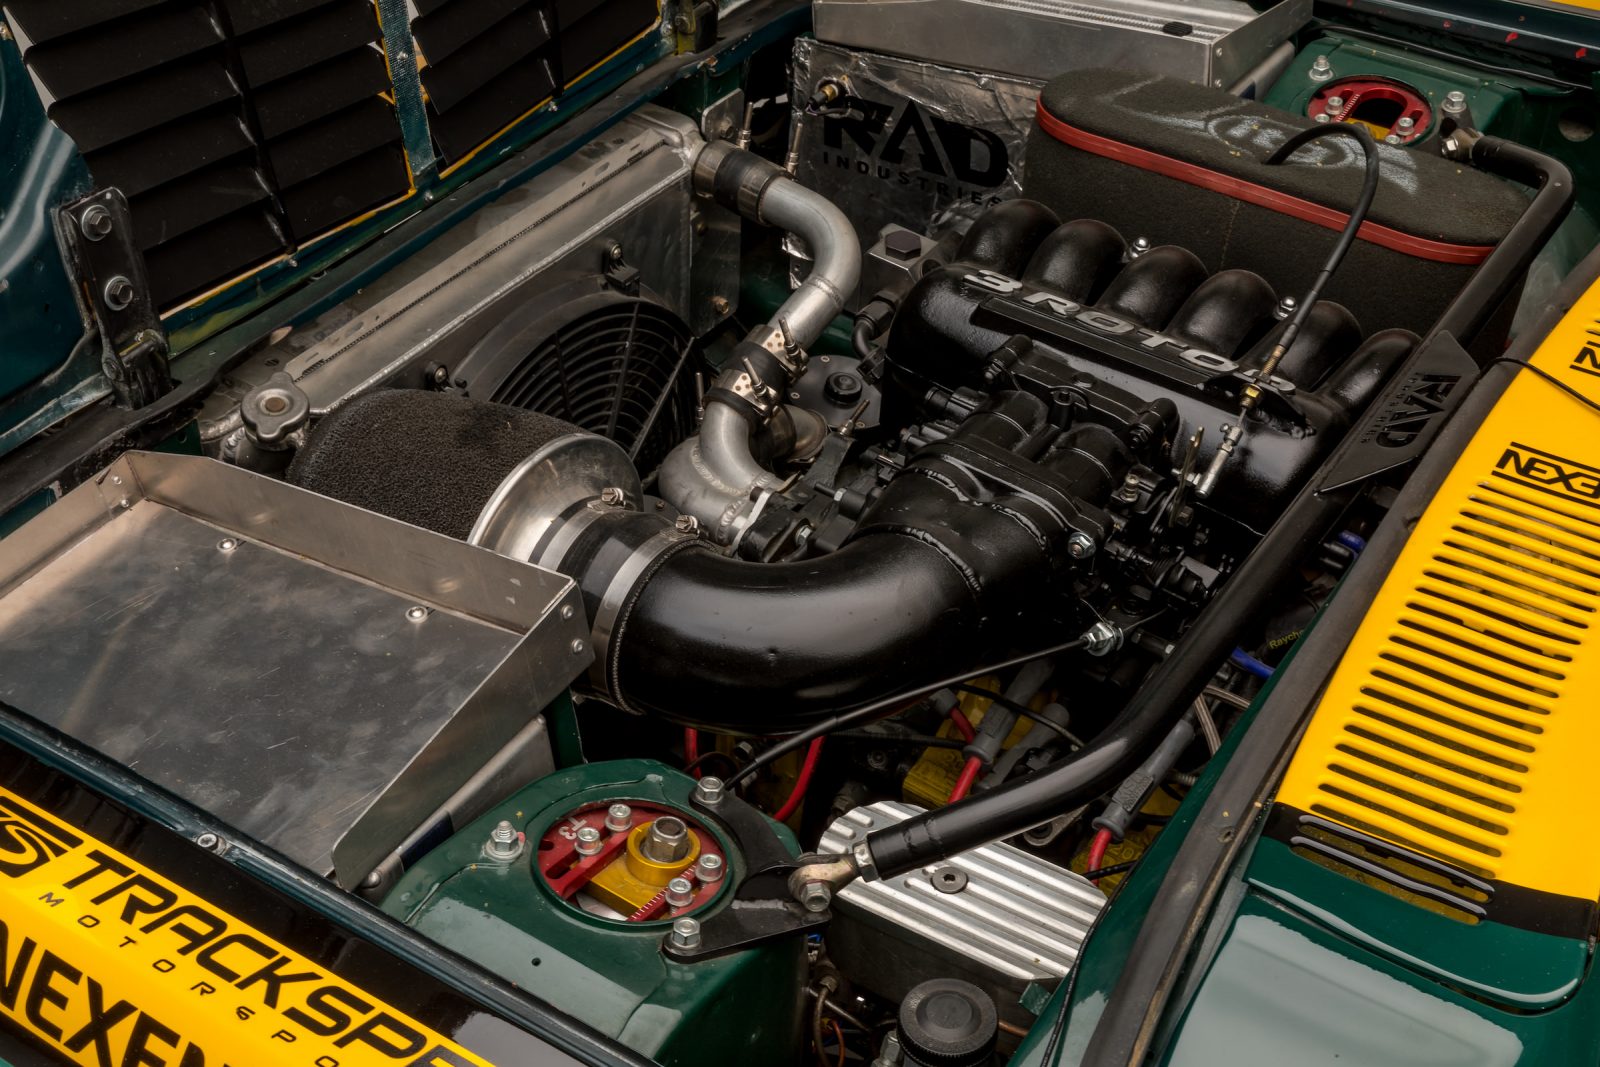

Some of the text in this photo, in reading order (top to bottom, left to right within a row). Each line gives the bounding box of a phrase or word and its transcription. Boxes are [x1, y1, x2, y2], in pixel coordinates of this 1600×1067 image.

[824, 96, 1009, 188] RAD
[823, 151, 1003, 208] INDUSTRIES
[963, 269, 1023, 294] 3
[1376, 374, 1462, 448] RAD
